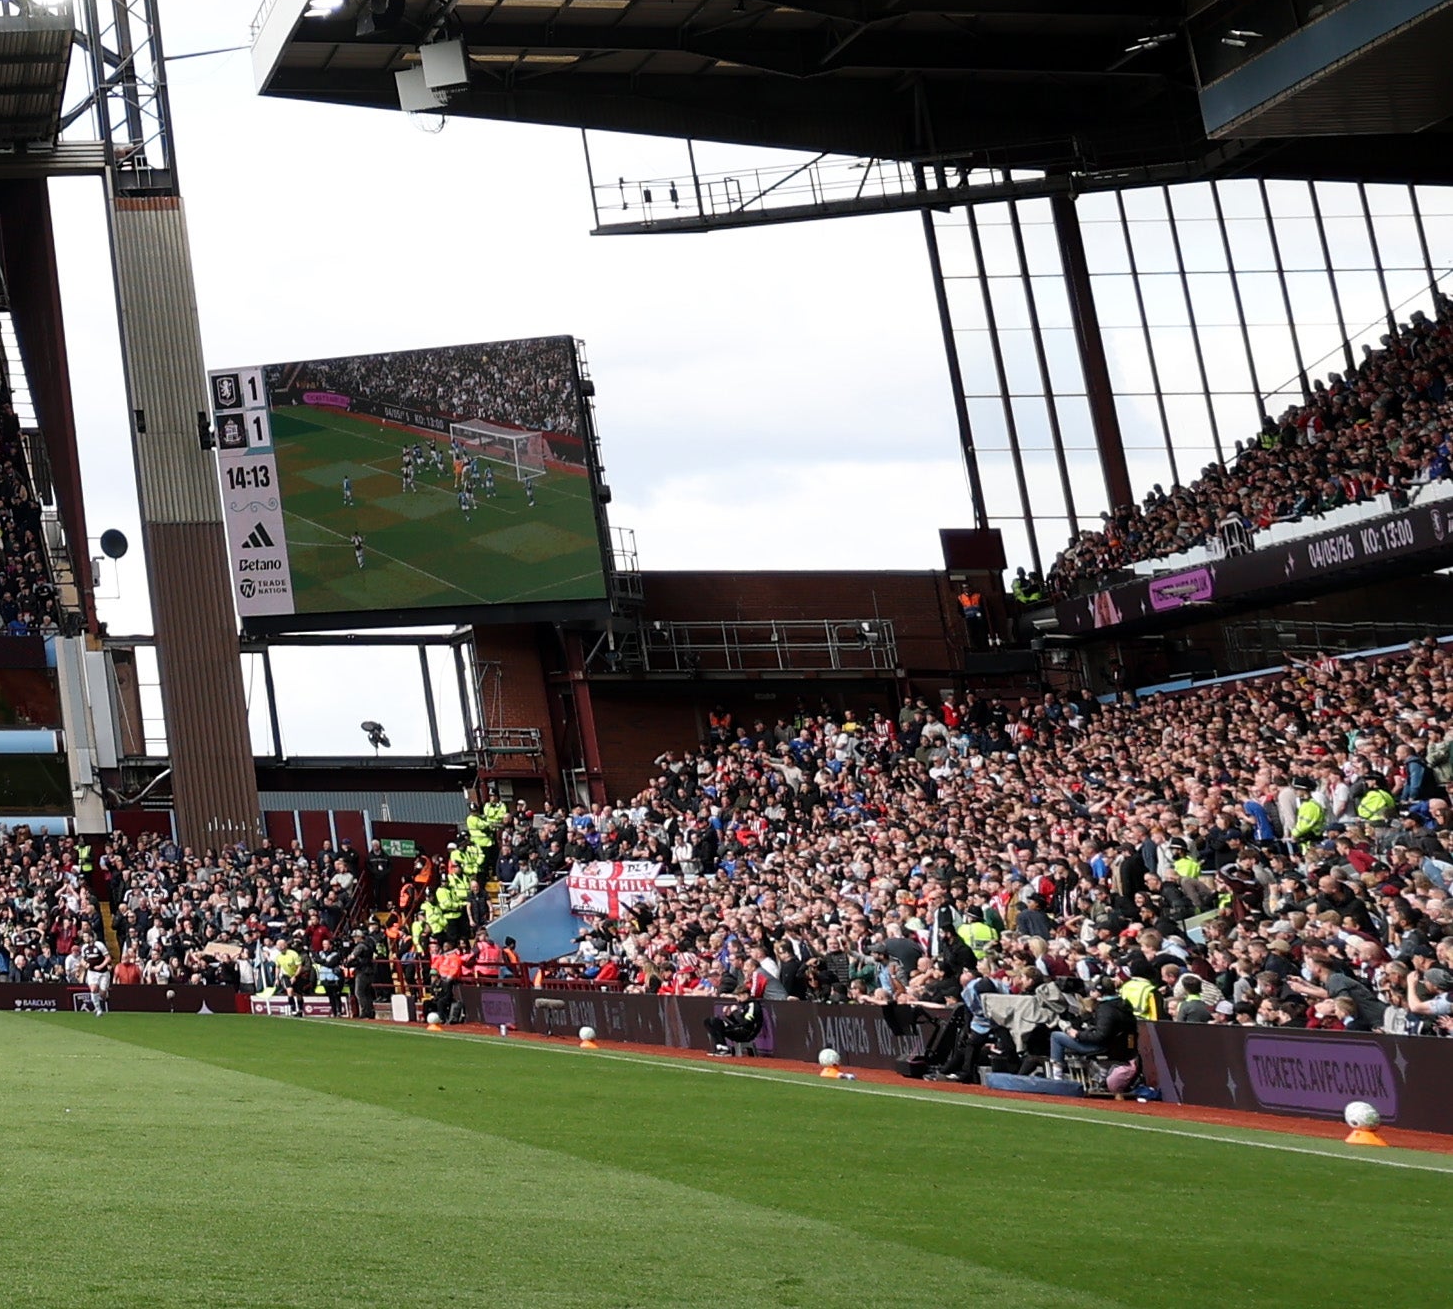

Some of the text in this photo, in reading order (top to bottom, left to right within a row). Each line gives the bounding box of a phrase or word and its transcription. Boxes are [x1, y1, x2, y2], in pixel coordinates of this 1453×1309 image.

[248, 376, 258, 401] 1
[252, 416, 263, 441] 1
[227, 465, 271, 490] 14:13
[1308, 518, 1414, 569] 04/05/26 KO: 13:00
[239, 559, 282, 572] Betano
[258, 580, 287, 588] TRADE
[258, 586, 288, 595] NATION
[1252, 1054, 1389, 1099] TICKETS.AVFC.CO.UK
